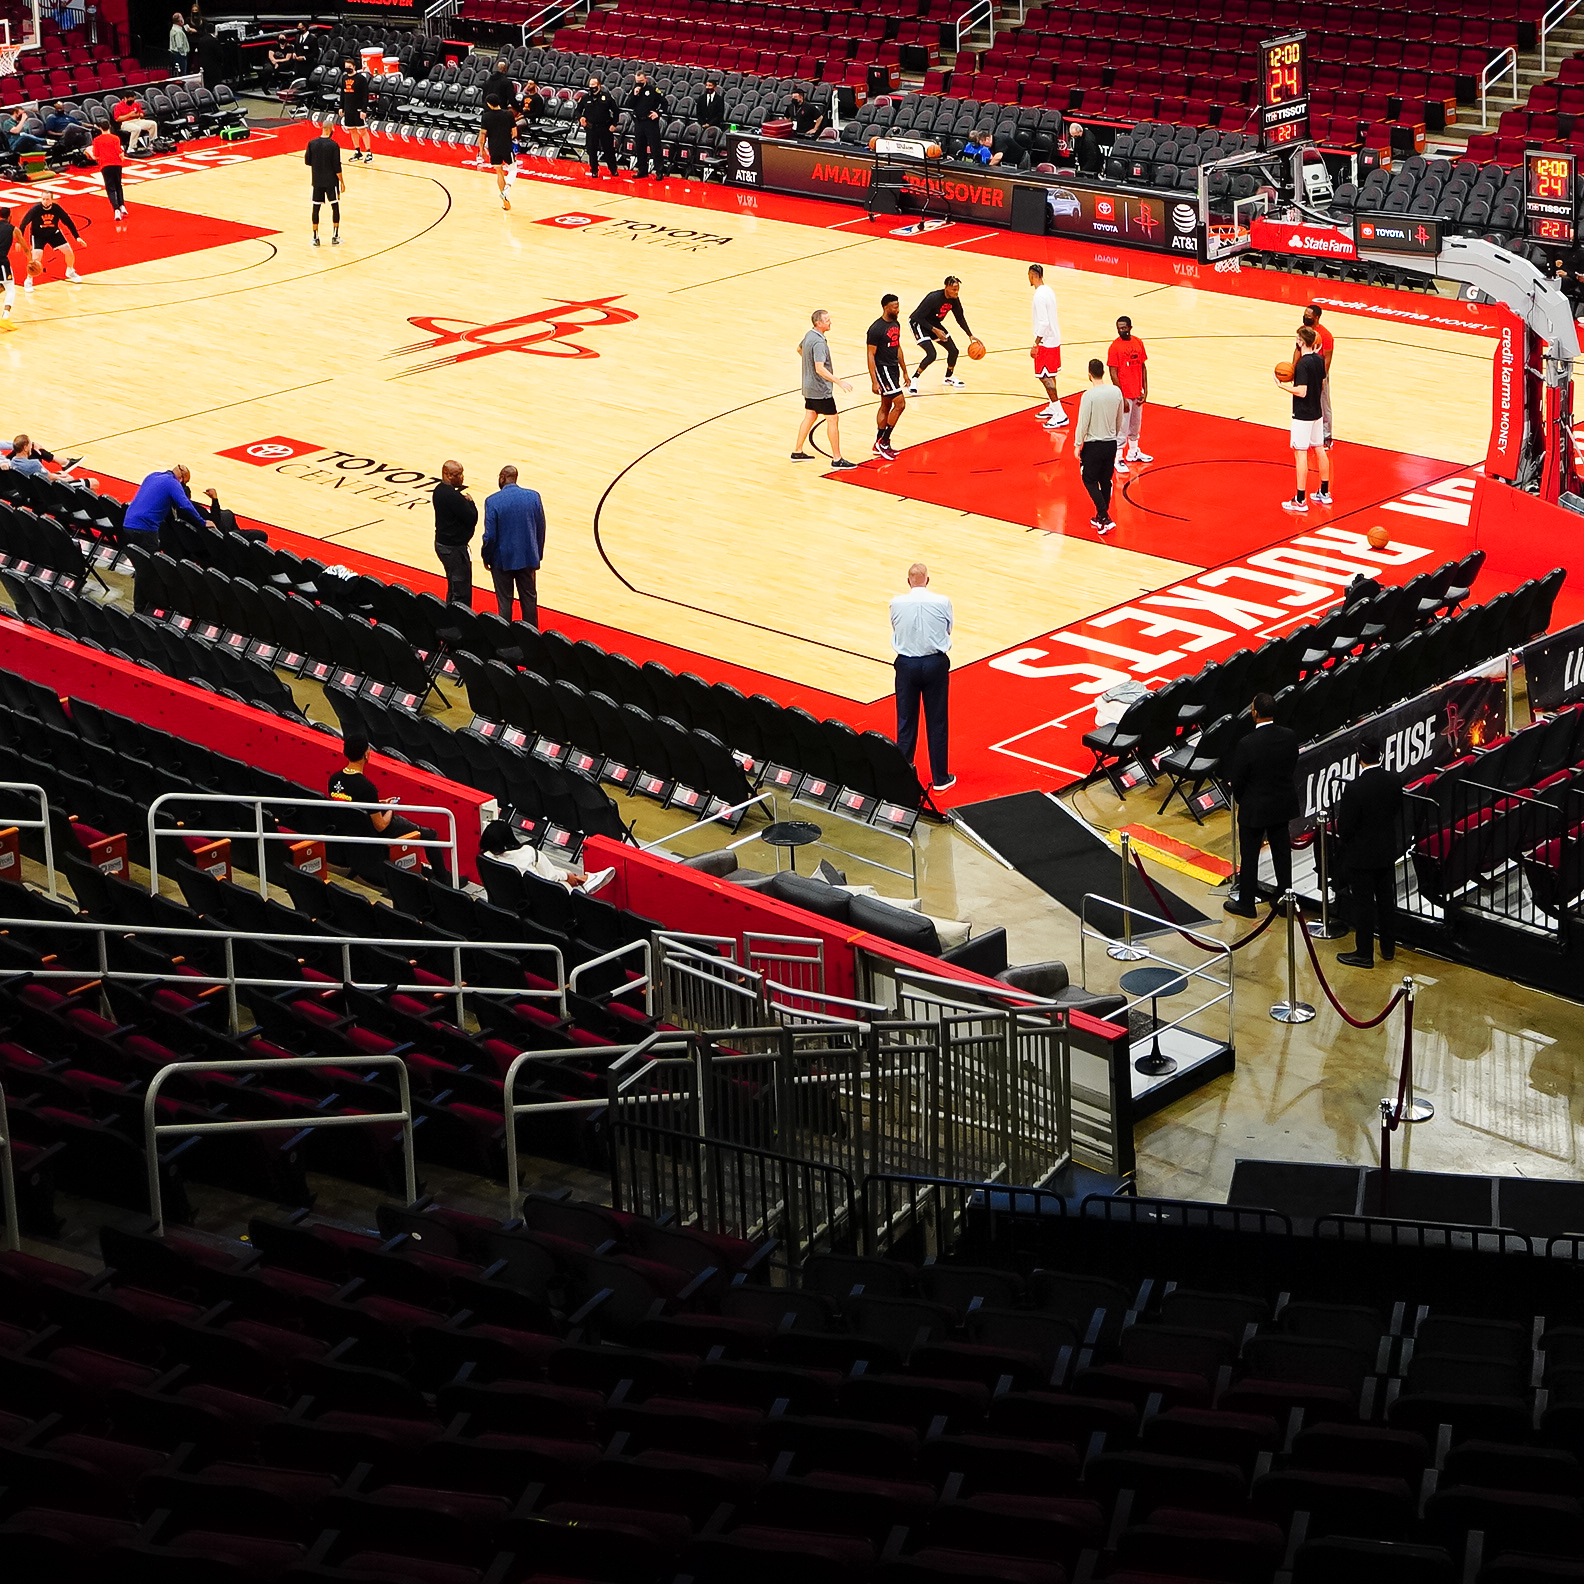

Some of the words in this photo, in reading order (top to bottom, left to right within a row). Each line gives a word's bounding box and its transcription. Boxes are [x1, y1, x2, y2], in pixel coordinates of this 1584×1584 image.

[1270, 43, 1300, 67] 12:00
[1271, 67, 1298, 103] 24
[312, 111, 320, 122] G
[1277, 103, 1307, 120] TISSOT
[370, 121, 378, 131] G
[896, 142, 914, 152] Wilson
[735, 169, 758, 184] AT&T
[811, 163, 871, 188] AMAZI
[1537, 159, 1568, 178] 12:00
[1539, 176, 1563, 198] 24
[1539, 203, 1571, 215] TISSOT
[582, 227, 708, 252] CENTER
[612, 219, 733, 246] TOYOTA
[1093, 222, 1119, 234] TOYOTA
[1376, 228, 1405, 239] TOYOTA
[1541, 221, 1570, 238] 2:21
[1466, 286, 1479, 299] G
[1312, 297, 1368, 310] credit
[1365, 304, 1430, 321] karma
[1430, 317, 1498, 331] MONEY
[1501, 327, 1514, 366] credit
[1501, 367, 1514, 410] karma
[1497, 411, 1510, 456] MONEY
[316, 450, 469, 495] TOYOT
[276, 463, 431, 510] CENTER
[1305, 752, 1361, 819] LIGH
[1384, 714, 1437, 774] FUSE
